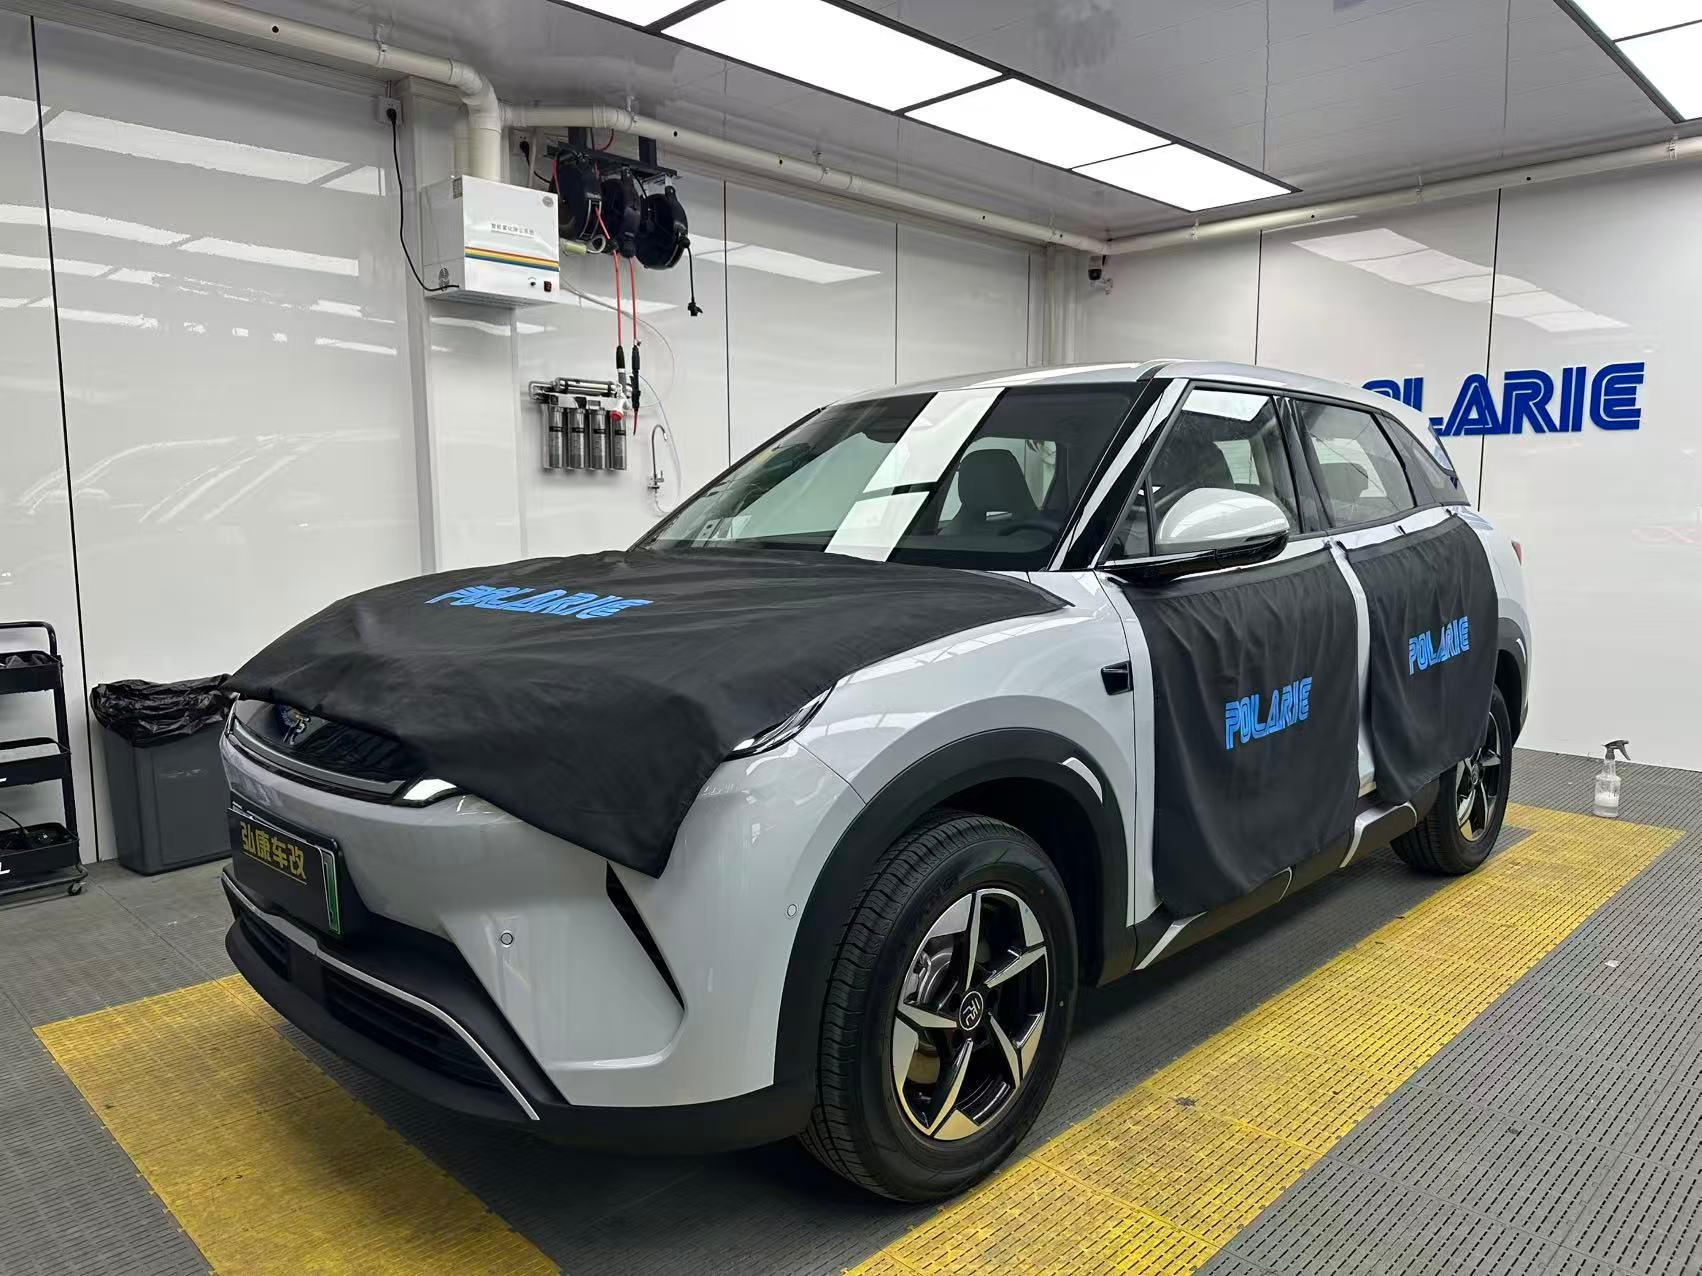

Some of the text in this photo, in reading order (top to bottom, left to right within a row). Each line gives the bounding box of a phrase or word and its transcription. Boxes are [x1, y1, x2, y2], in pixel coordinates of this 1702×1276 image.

[1408, 616, 1469, 676] POLARIE
[1225, 676, 1312, 749] POLARIE
[240, 821, 308, 880] 弘康车改
